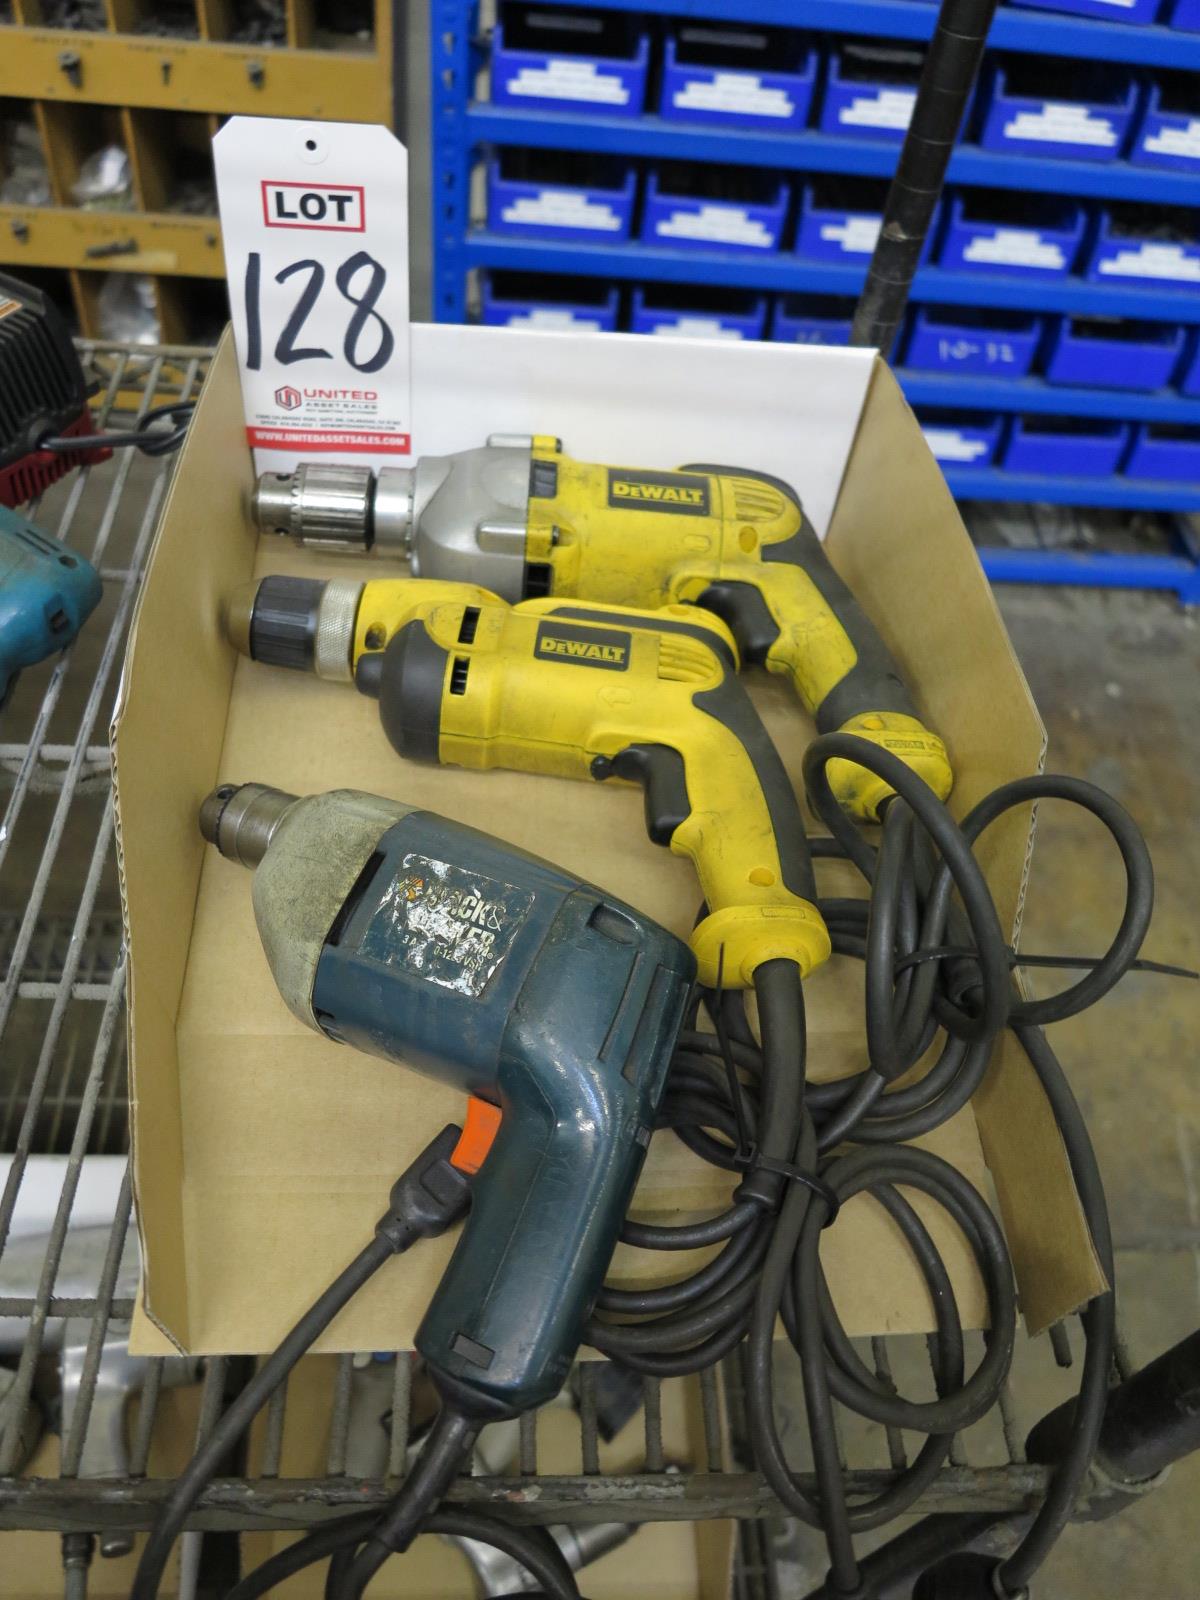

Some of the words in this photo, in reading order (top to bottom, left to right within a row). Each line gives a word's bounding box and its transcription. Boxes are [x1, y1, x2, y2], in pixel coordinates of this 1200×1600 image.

[274, 191, 353, 222] LOT
[245, 251, 394, 373] 128
[304, 388, 378, 401] UNITED
[254, 430, 406, 446] WWW.UNITEDASSETSALES.COM
